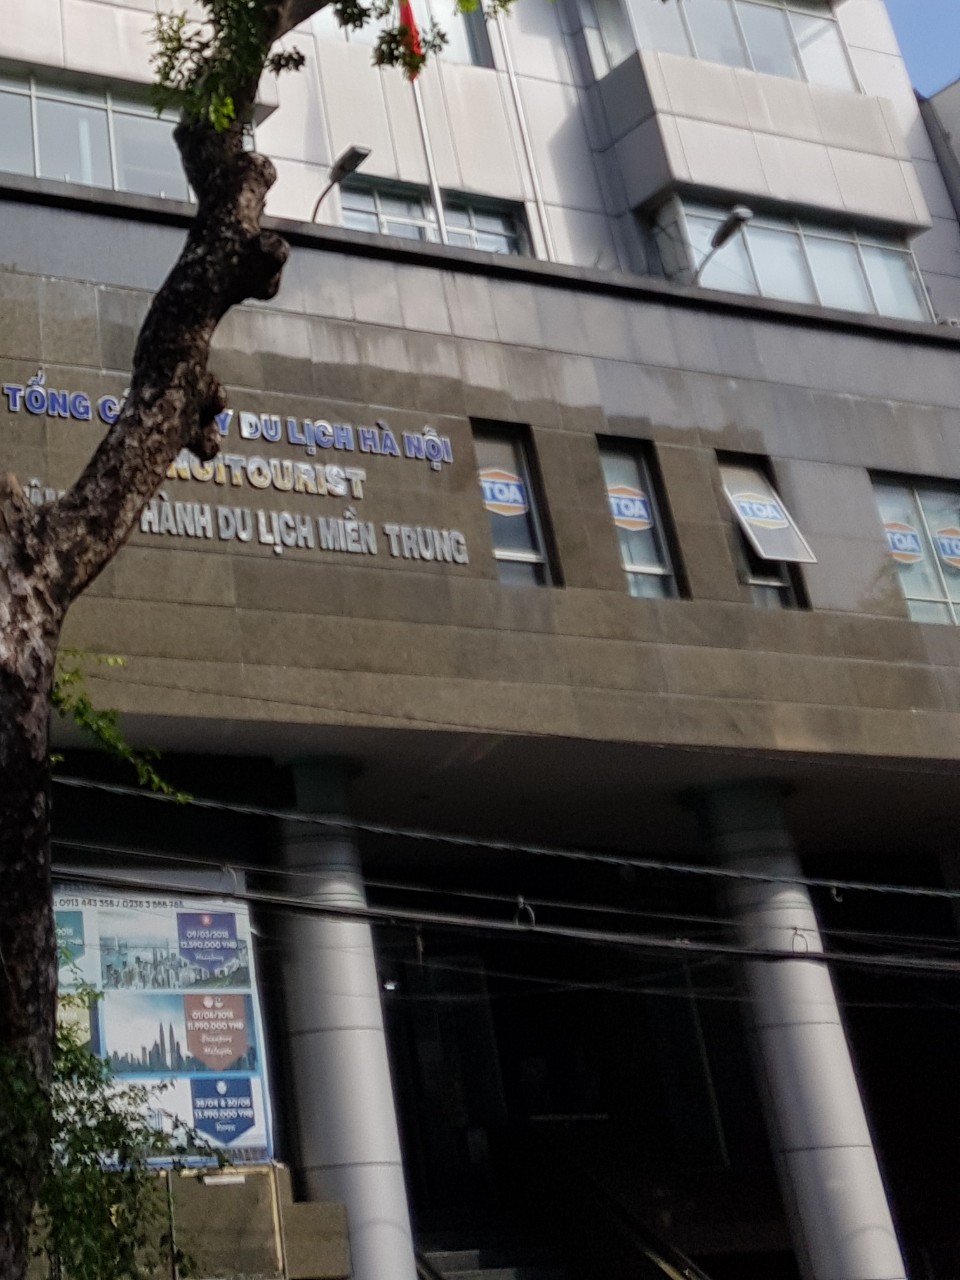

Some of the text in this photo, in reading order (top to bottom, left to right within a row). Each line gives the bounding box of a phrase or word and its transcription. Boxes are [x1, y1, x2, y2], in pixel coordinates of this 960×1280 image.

[3, 367, 91, 420] TỔNG
[239, 411, 282, 442] DU
[287, 416, 354, 455] LỊCH
[358, 420, 401, 456] HÀ
[402, 425, 453, 470] NỘI
[481, 478, 524, 505] TOA
[610, 496, 649, 520] TOA
[740, 500, 784, 523] TOA
[216, 505, 253, 542] DU
[256, 509, 315, 554] LỊCH
[318, 506, 378, 555] MIỀN
[383, 522, 469, 564] TRUNG
